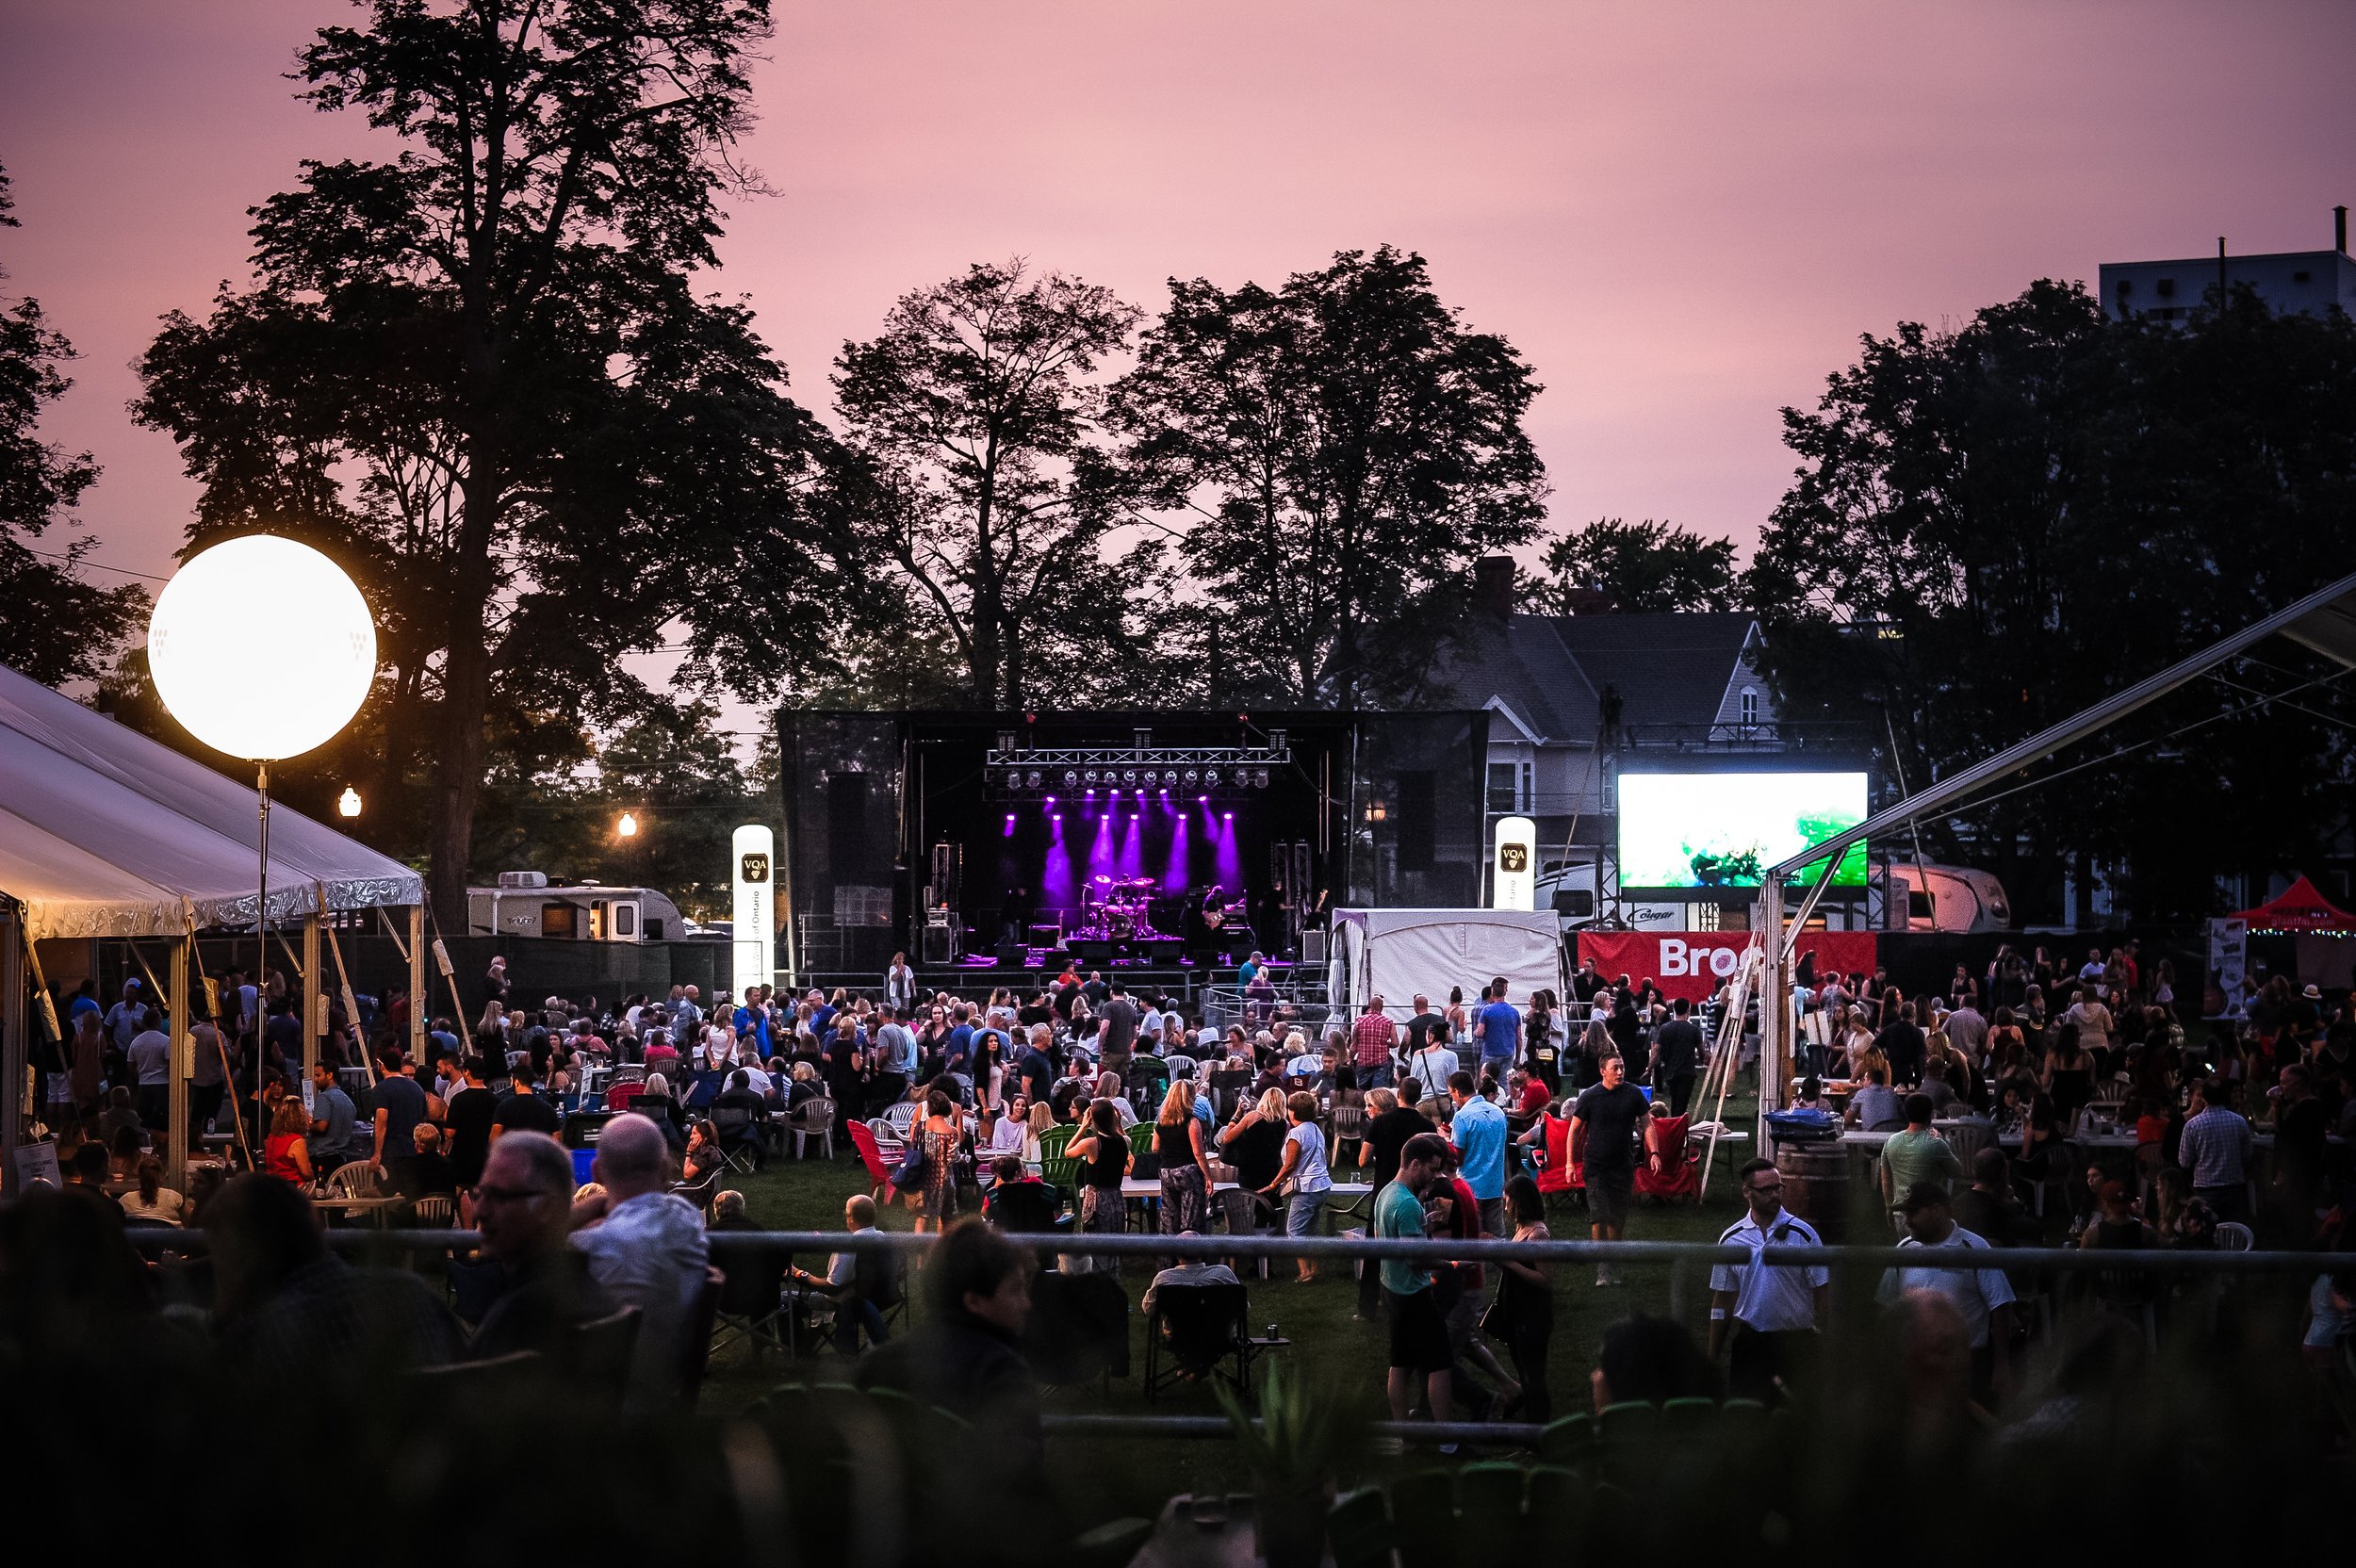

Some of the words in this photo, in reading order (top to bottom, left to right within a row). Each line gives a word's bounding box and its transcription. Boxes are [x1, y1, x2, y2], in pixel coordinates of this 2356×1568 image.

[1503, 849, 1525, 859] VQA
[744, 860, 767, 871] VQA
[1627, 907, 1675, 923] Cougar
